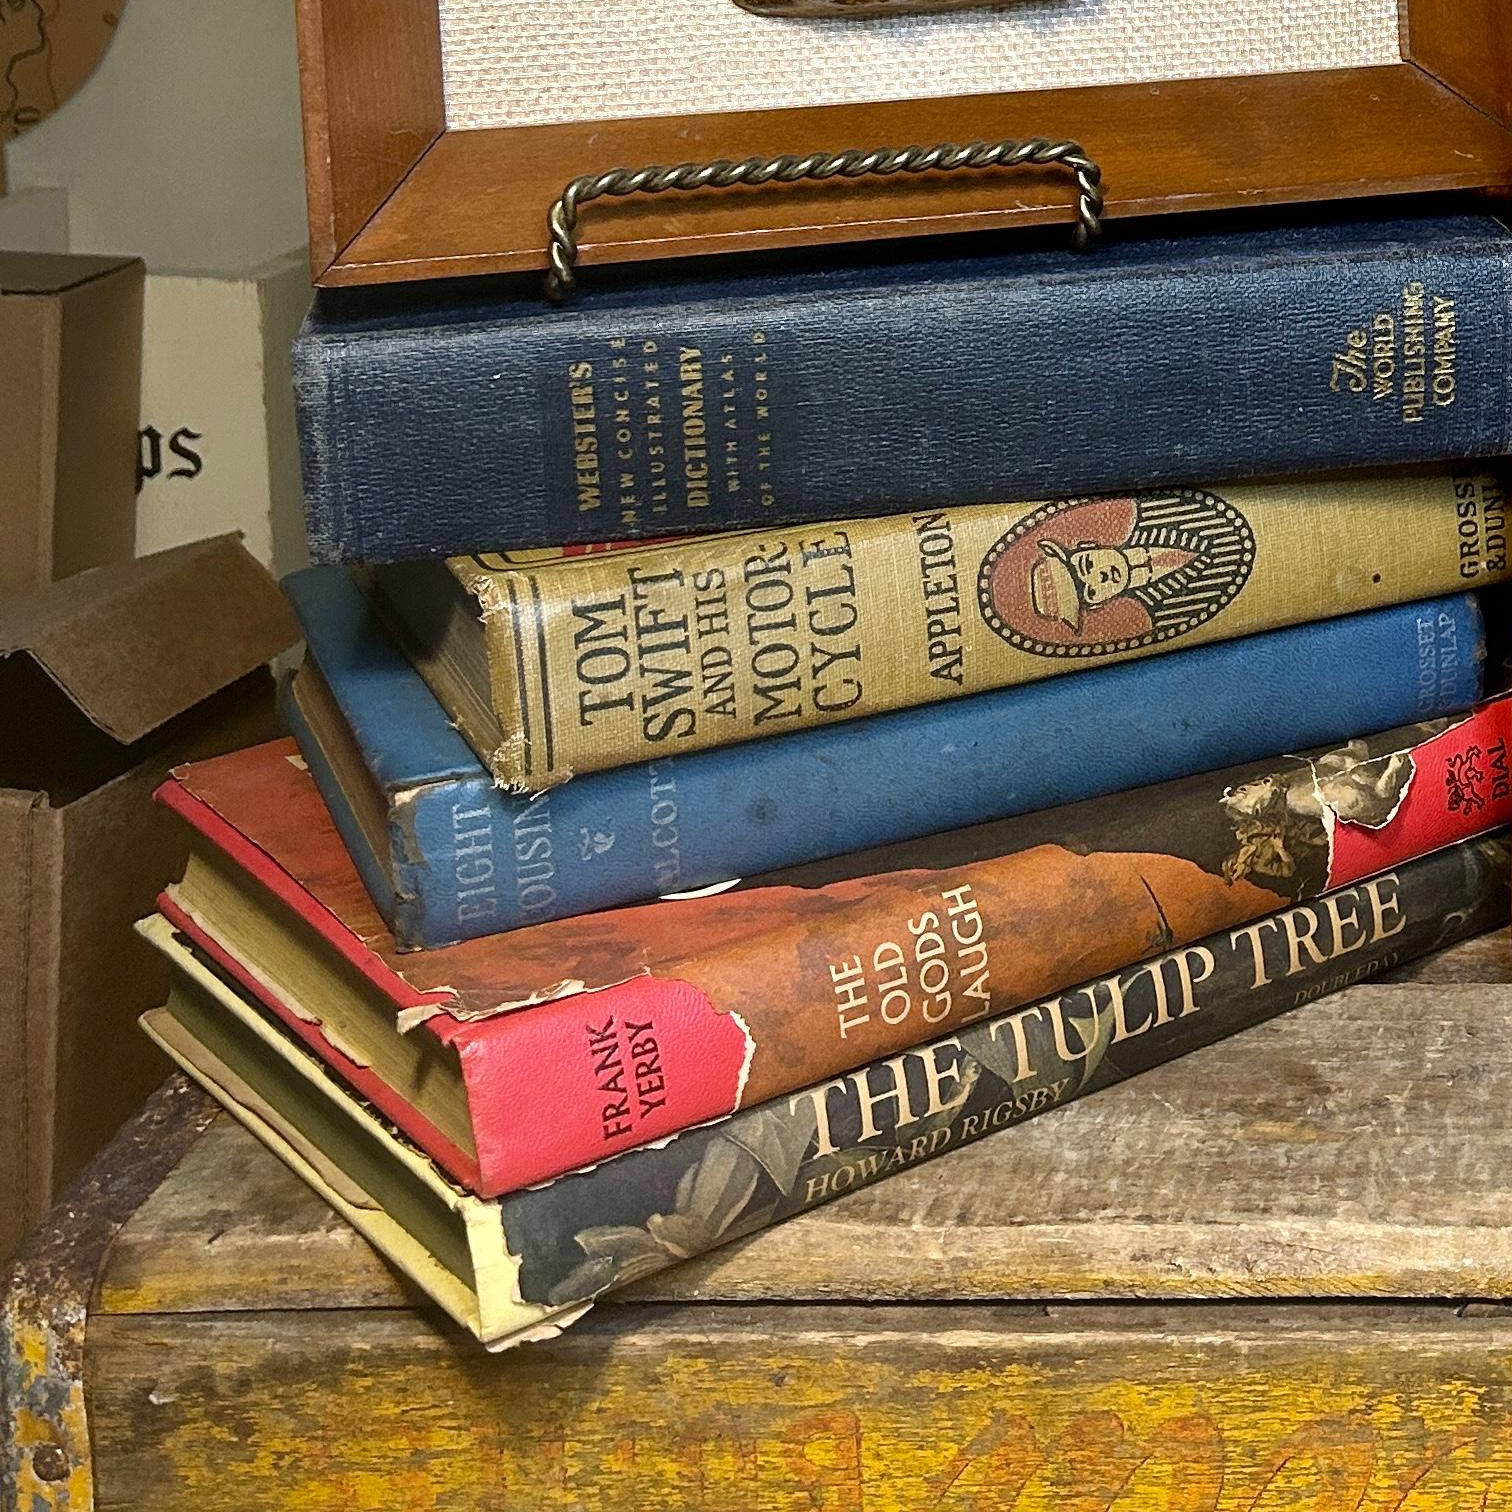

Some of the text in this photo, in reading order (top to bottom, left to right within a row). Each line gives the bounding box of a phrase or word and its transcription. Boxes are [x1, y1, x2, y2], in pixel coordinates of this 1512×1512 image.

[720, 352, 738, 432] ATLAS
[1329, 328, 1368, 394] The
[1372, 312, 1398, 401] WORLD
[1401, 280, 1427, 423] PUBLISHING
[1431, 295, 1457, 409] COMPANY
[568, 360, 602, 513] WEBSTER'S
[609, 337, 637, 527] NEW CONCISE
[642, 339, 668, 514] ILLUSTRATED
[679, 345, 712, 510] DICTIONARY
[752, 330, 776, 507] OF THE WORLD
[1452, 464, 1481, 580] GROSSE
[570, 593, 637, 726] TOM
[626, 566, 699, 744] SWIFT
[692, 566, 737, 719] AND HIS
[798, 530, 864, 713] CYCLE
[911, 511, 964, 687] APPLETON
[1487, 736, 1511, 801] DIAL
[451, 802, 498, 926] EIGHT
[788, 872, 1409, 1160] THE TULIP TREE
[828, 953, 873, 1040] THE
[872, 940, 913, 1026] OLD
[906, 910, 953, 1025] GODS
[941, 883, 993, 1025] LAUGH
[585, 1015, 633, 1142] FRANK
[623, 1019, 667, 1119] YERBY
[803, 1076, 1073, 1205] HOWARD RIGSBY
